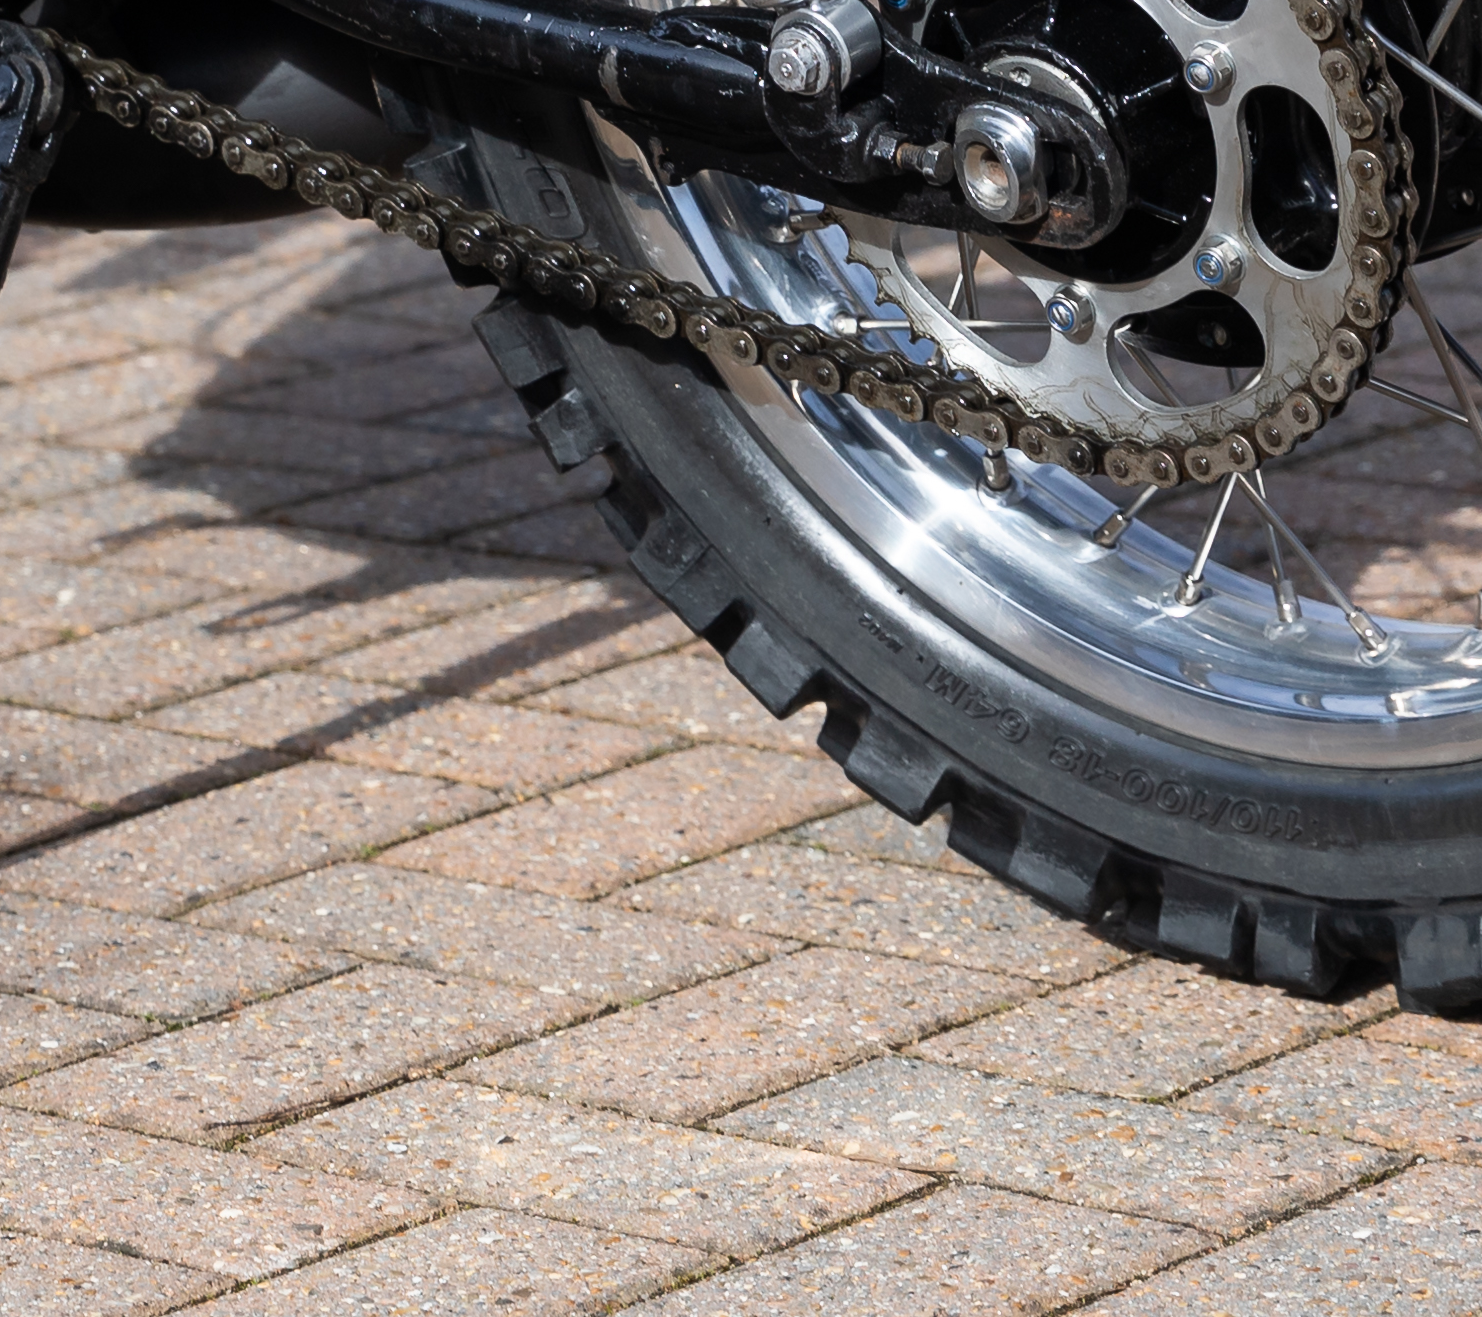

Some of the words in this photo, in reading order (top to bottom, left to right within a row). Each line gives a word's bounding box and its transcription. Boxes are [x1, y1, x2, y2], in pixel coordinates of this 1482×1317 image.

[859, 612, 904, 655] M402
[924, 664, 1030, 744] 64M
[1048, 736, 1306, 843] 110/100-18
